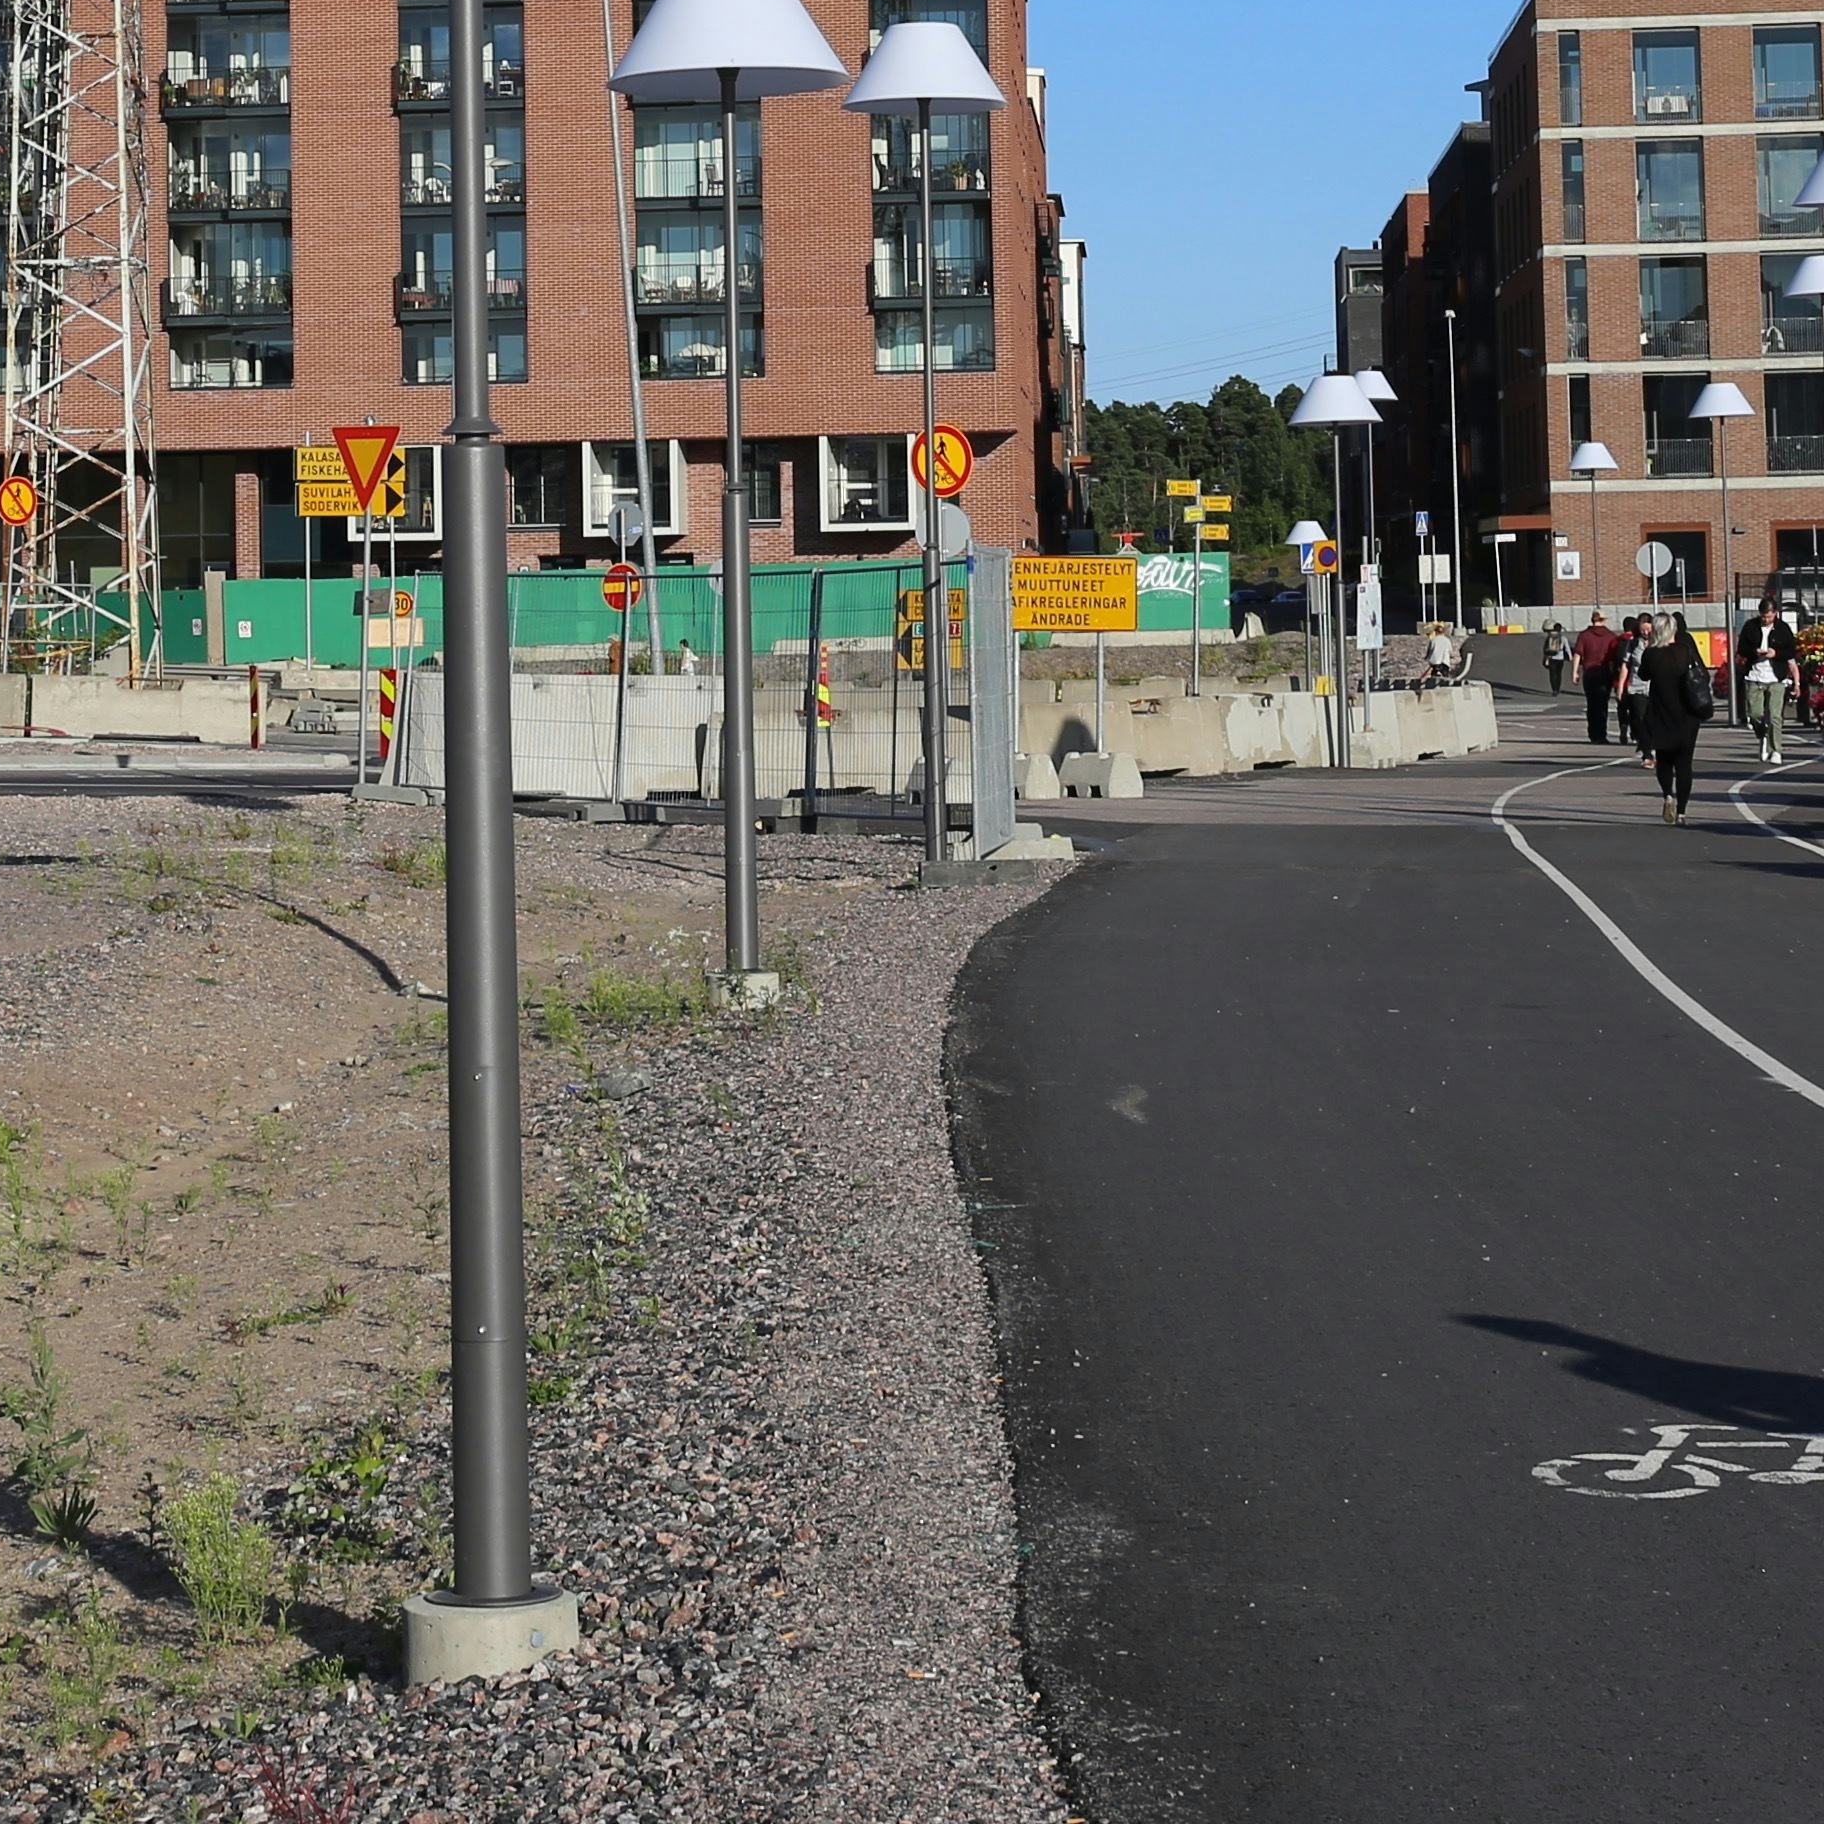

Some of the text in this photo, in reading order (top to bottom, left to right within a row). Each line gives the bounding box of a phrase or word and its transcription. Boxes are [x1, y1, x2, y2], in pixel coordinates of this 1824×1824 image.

[301, 451, 341, 463] KALASA
[301, 464, 348, 476] FISKEHA
[303, 487, 357, 498] SUVILAH
[1009, 561, 1133, 575] ENNEJÄRJESTELYT
[1018, 579, 1105, 592] MUUTTUNEET
[1011, 595, 1127, 609] AFIKREGLERINGAR
[1031, 611, 1091, 626] ÄNDRADE
